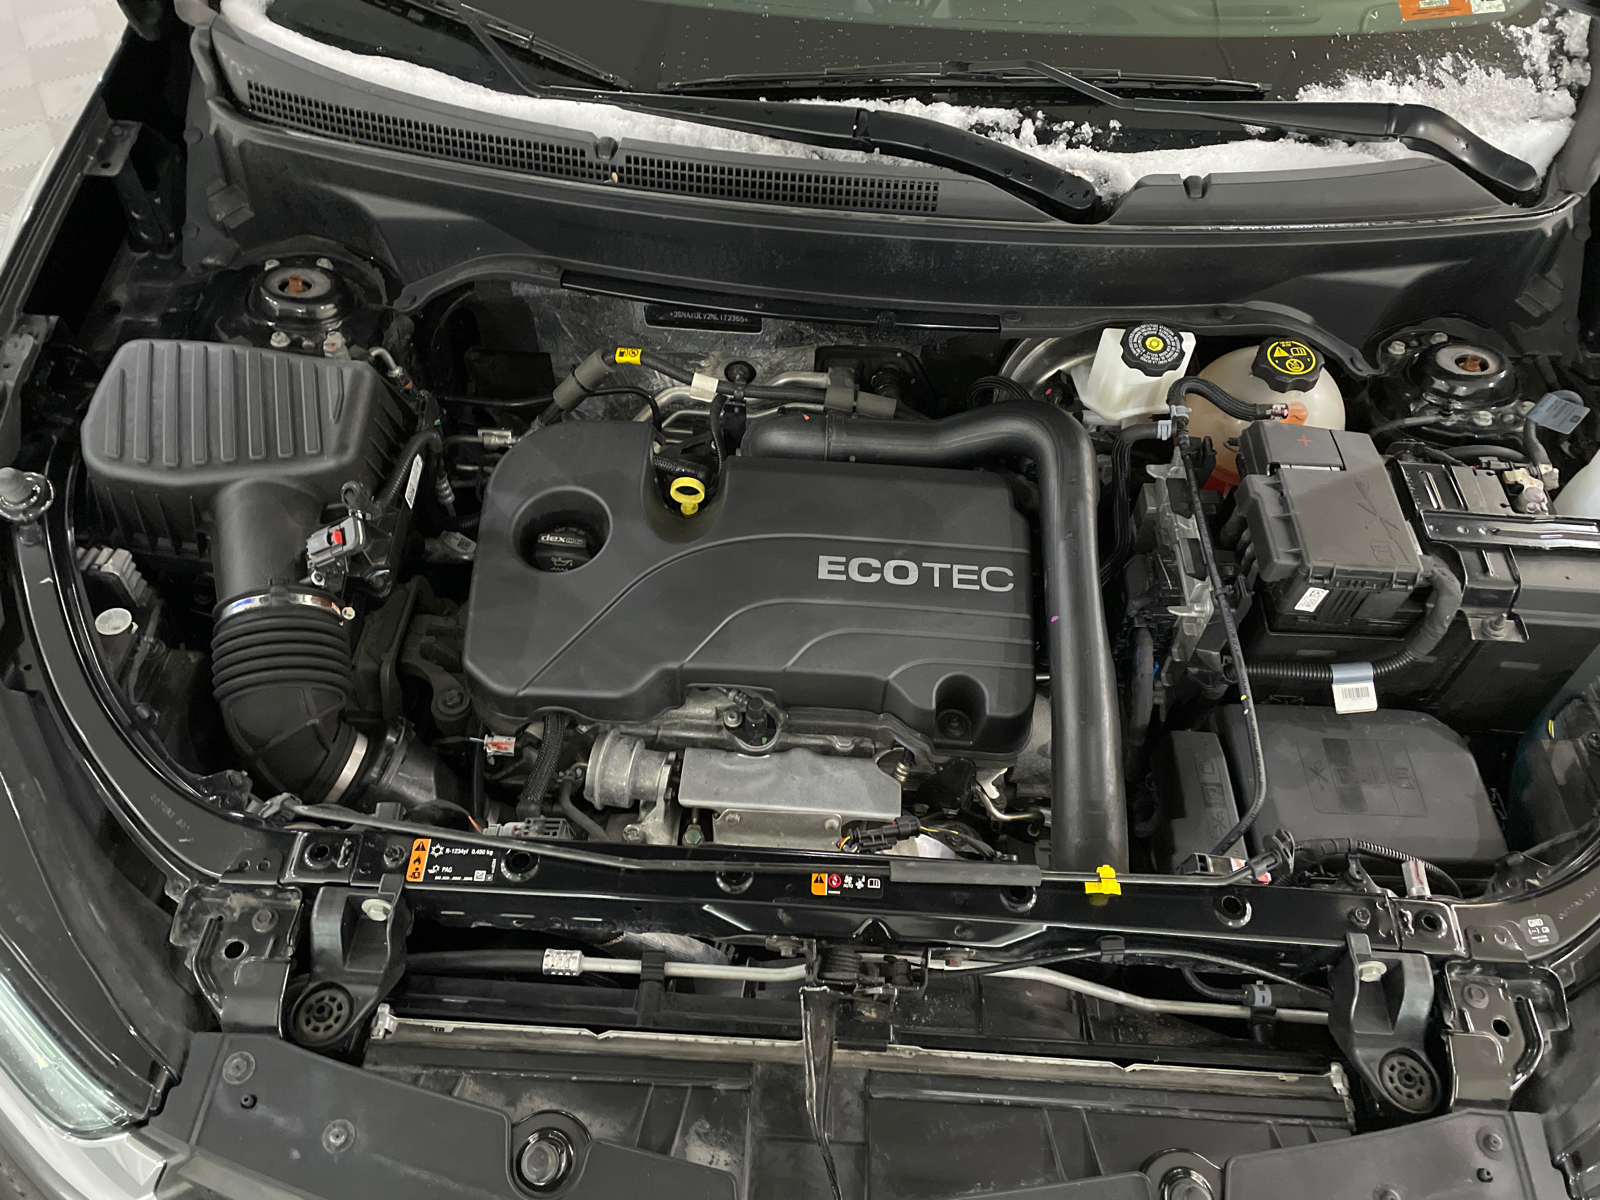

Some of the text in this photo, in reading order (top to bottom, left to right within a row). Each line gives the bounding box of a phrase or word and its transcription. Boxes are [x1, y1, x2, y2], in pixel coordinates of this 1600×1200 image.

[817, 555, 1014, 592] ECOTEC
[445, 847, 469, 856] R-1234yf
[486, 849, 494, 857] kg
[1528, 918, 1543, 927] GND
